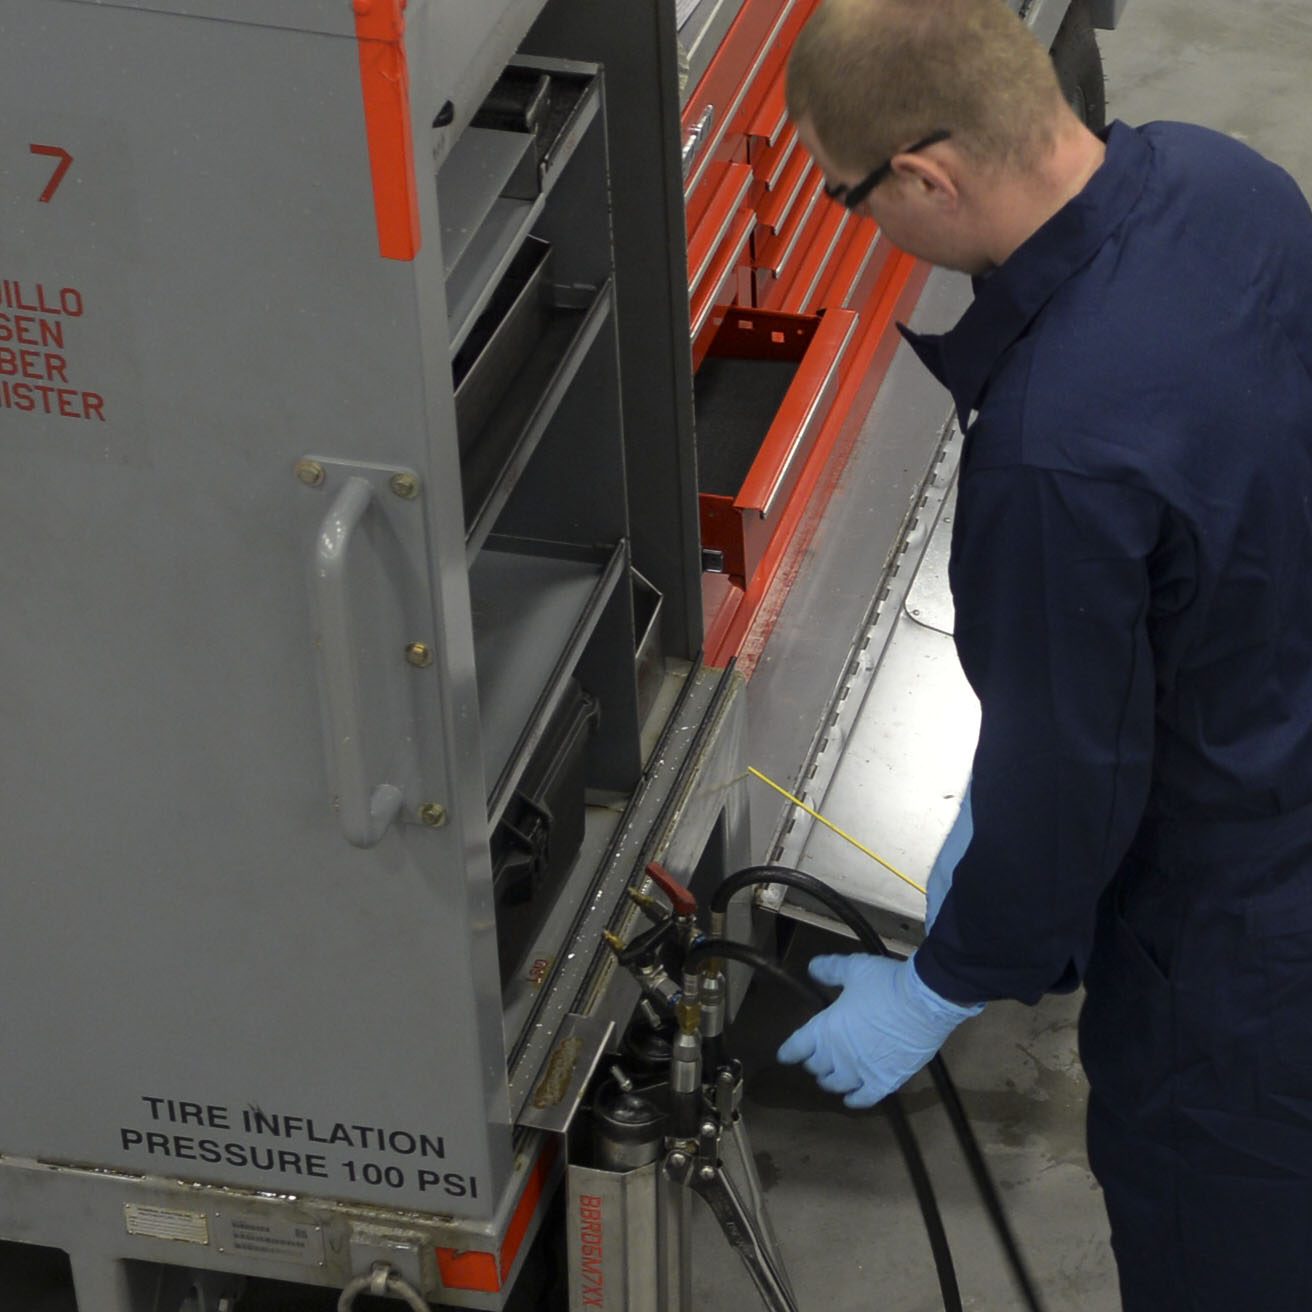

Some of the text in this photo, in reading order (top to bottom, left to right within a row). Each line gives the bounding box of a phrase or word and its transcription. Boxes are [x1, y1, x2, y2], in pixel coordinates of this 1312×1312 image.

[29, 144, 74, 203] 7
[0, 279, 84, 318] ILLO
[0, 380, 106, 422] ISTER
[142, 1096, 445, 1159] TIRE INFLATION
[120, 1128, 478, 1199] PRESSURE 100 PSI
